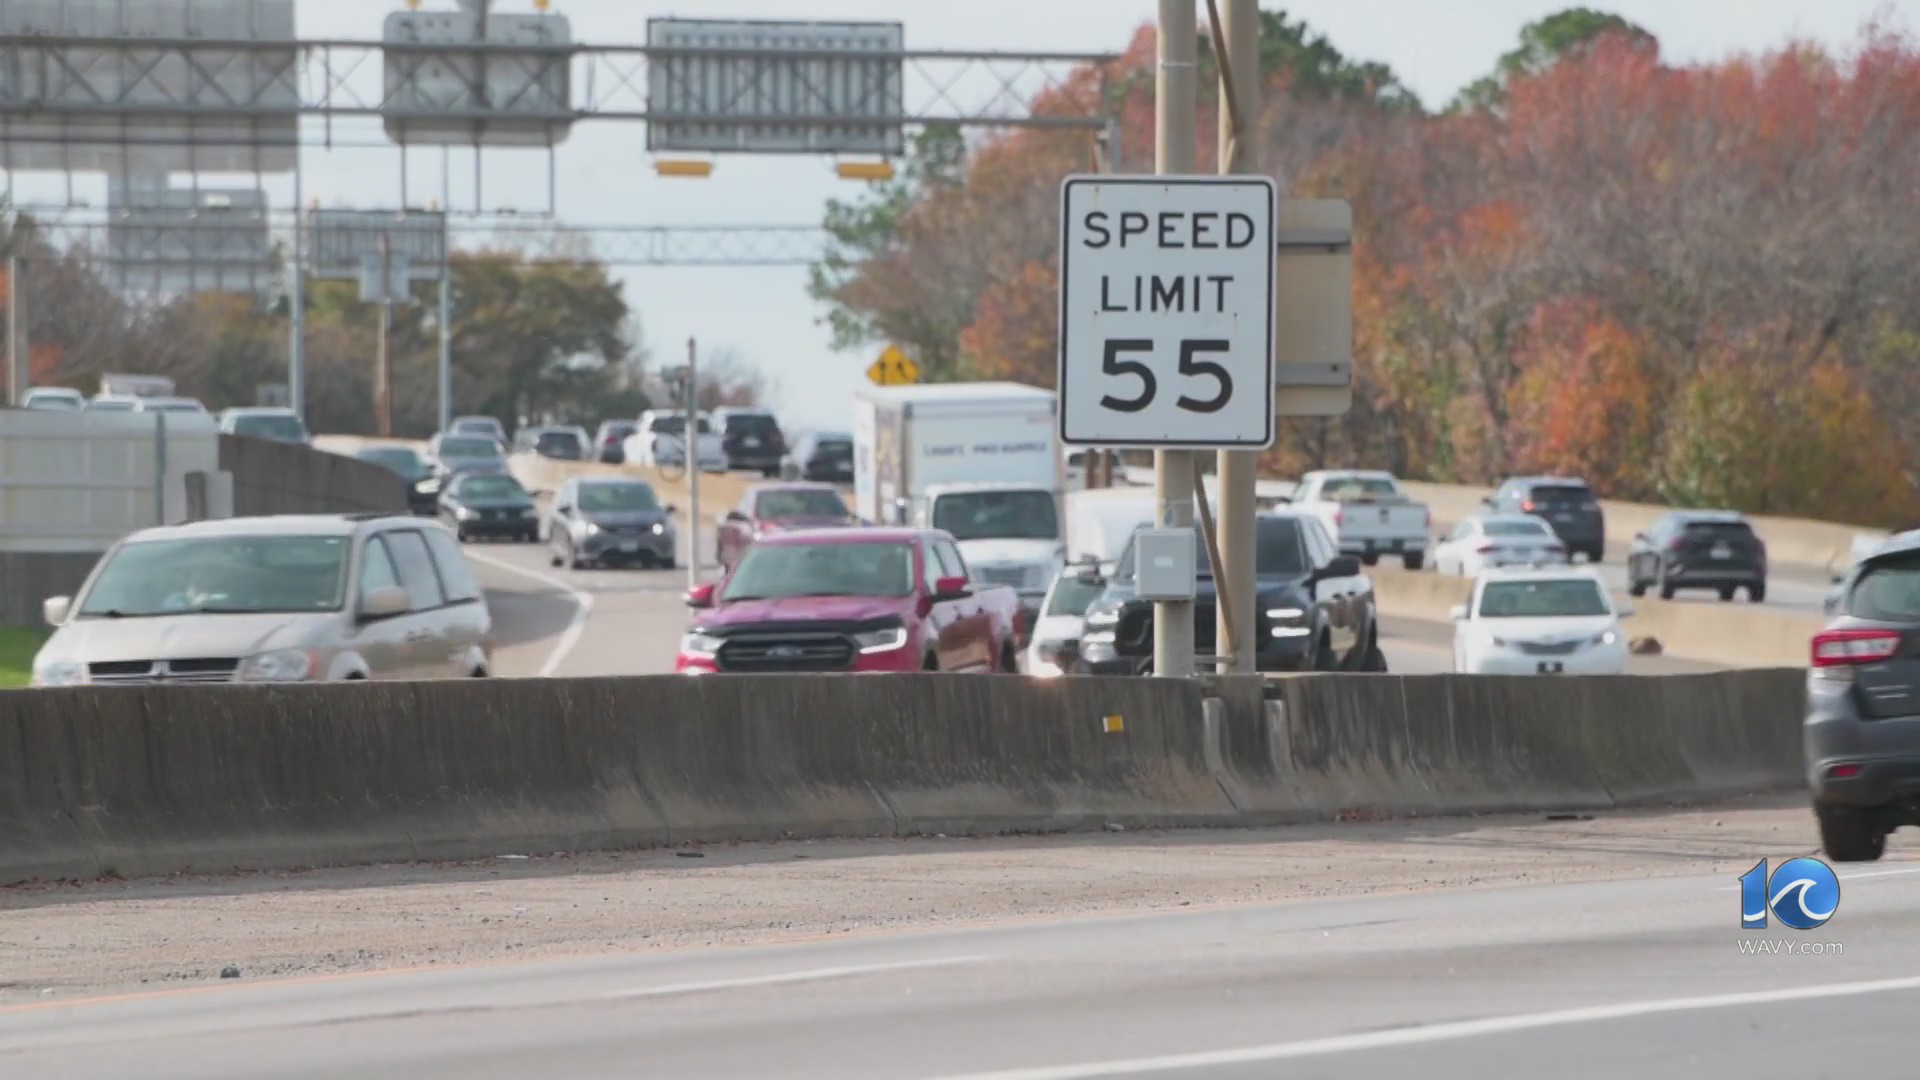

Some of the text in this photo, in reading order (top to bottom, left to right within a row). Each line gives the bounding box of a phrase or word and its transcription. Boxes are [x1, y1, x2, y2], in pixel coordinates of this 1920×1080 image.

[1083, 211, 1255, 249] SPEED
[1101, 275, 1234, 312] LIMIT
[1100, 339, 1233, 413] 55
